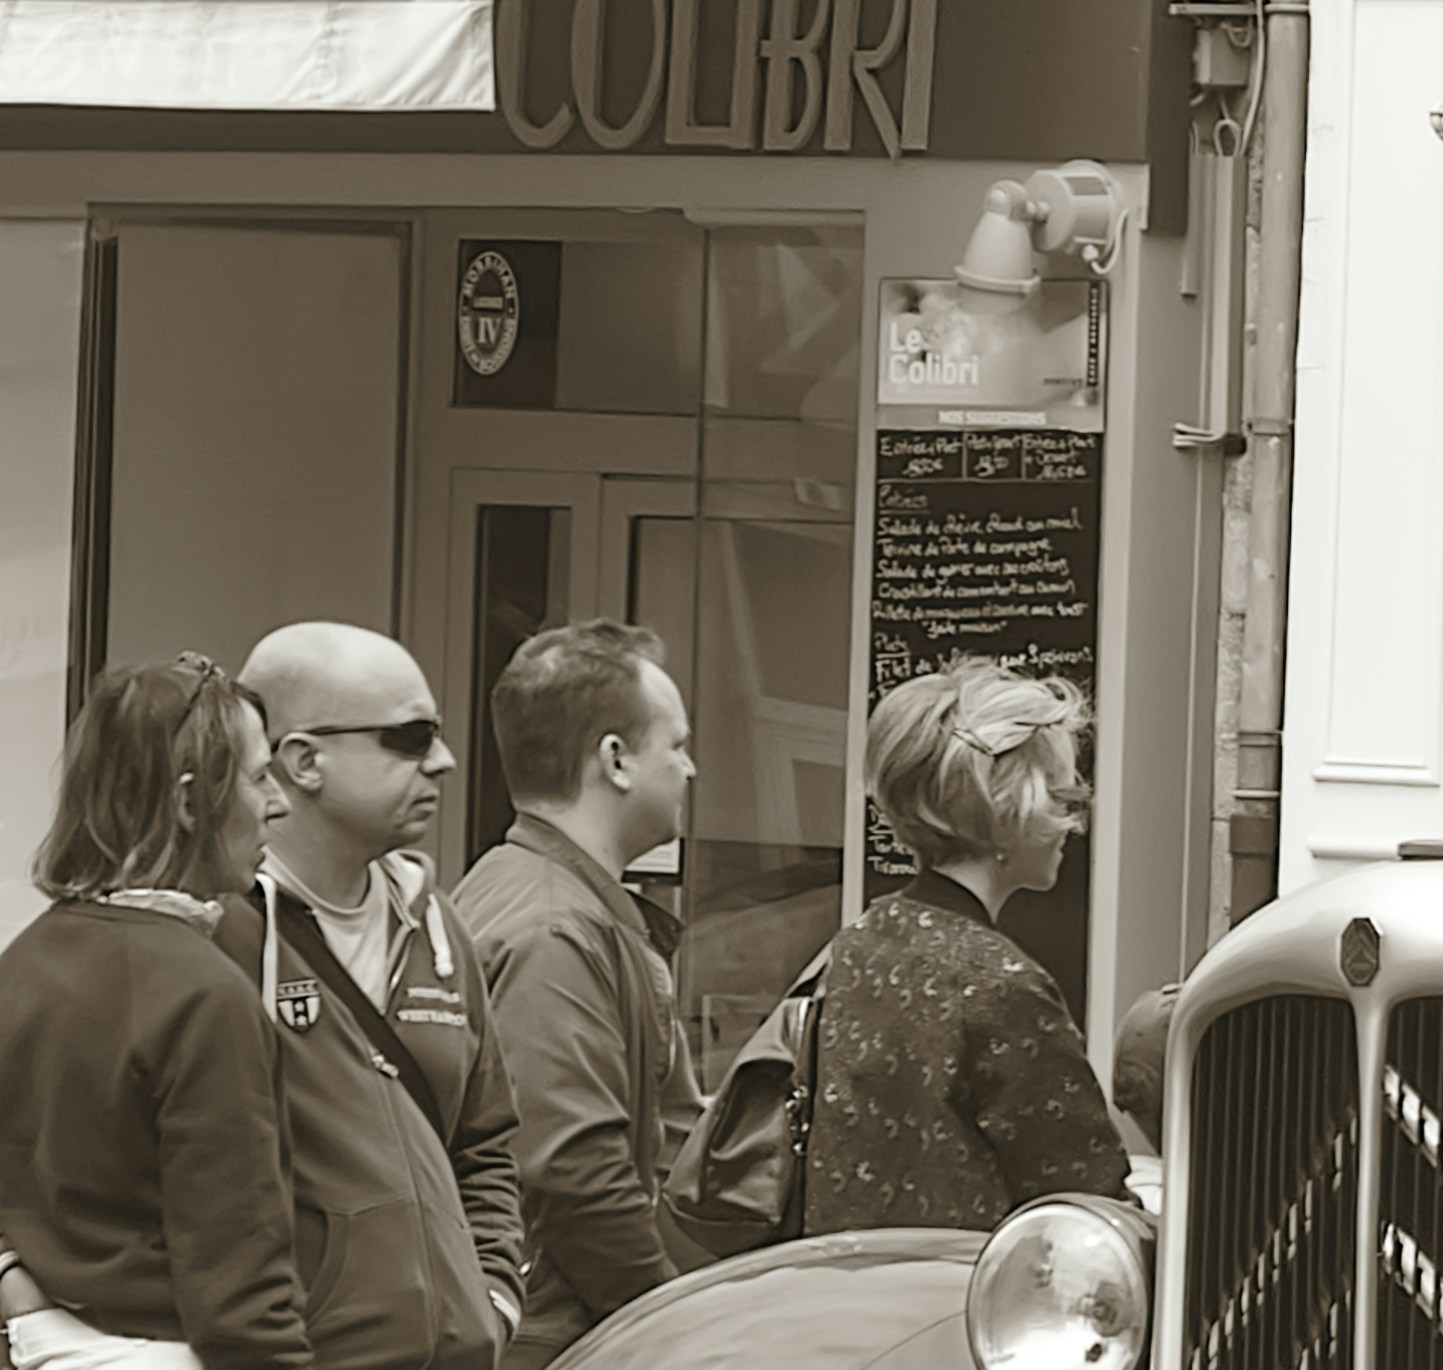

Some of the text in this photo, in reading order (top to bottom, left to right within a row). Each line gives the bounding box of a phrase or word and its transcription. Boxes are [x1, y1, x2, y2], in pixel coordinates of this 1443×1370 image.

[499, 0, 937, 159] COLIBRI
[476, 316, 502, 345] IV
[889, 321, 922, 352] Le
[889, 353, 979, 385] Colibri
